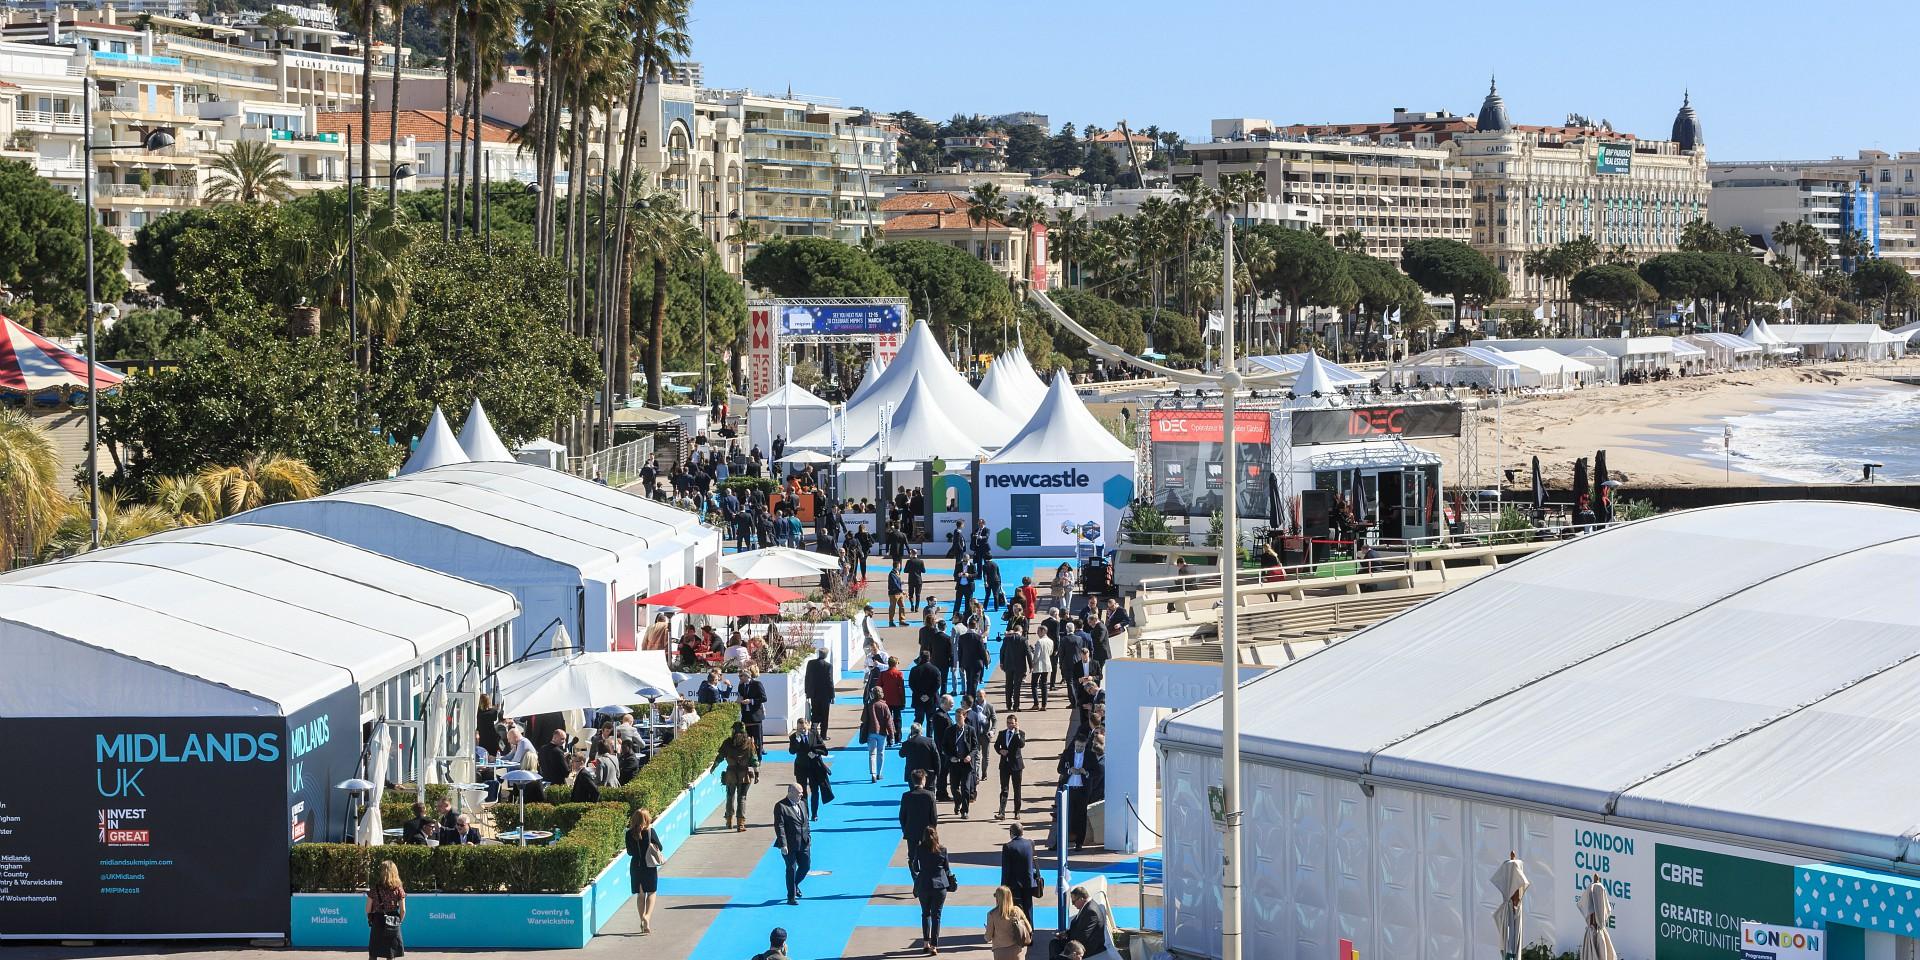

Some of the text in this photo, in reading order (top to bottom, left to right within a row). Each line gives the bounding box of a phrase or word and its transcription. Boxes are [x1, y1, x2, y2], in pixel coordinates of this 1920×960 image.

[1159, 419, 1188, 432] IDEC
[1348, 408, 1405, 435] IDEC
[985, 468, 1090, 488] newcastle
[291, 713, 330, 760] MIDLANDS
[96, 732, 280, 763] MIDLANDS
[96, 768, 146, 797] UK
[291, 760, 305, 793] UK
[107, 809, 147, 819] INVEST
[107, 819, 119, 829] IN
[109, 831, 148, 841] GREAT
[1574, 829, 1634, 855] LONDON
[100, 858, 173, 867] midlandsukmipim.com
[1574, 851, 1610, 873] CLUB
[101, 873, 145, 881] @UKMidlands
[1660, 862, 1704, 887] CBRE
[1575, 873, 1632, 899] LONGE
[5, 895, 57, 903] Wolverhampton
[311, 916, 348, 925] Midlands
[319, 907, 340, 916] West
[429, 912, 457, 920] Solihull
[527, 917, 575, 926] Warwickshire
[531, 908, 563, 918] Coventry
[1660, 902, 1713, 926] GREATER
[1660, 922, 1741, 953] OPPORTUNITIE
[1744, 928, 1820, 953] LONDON
